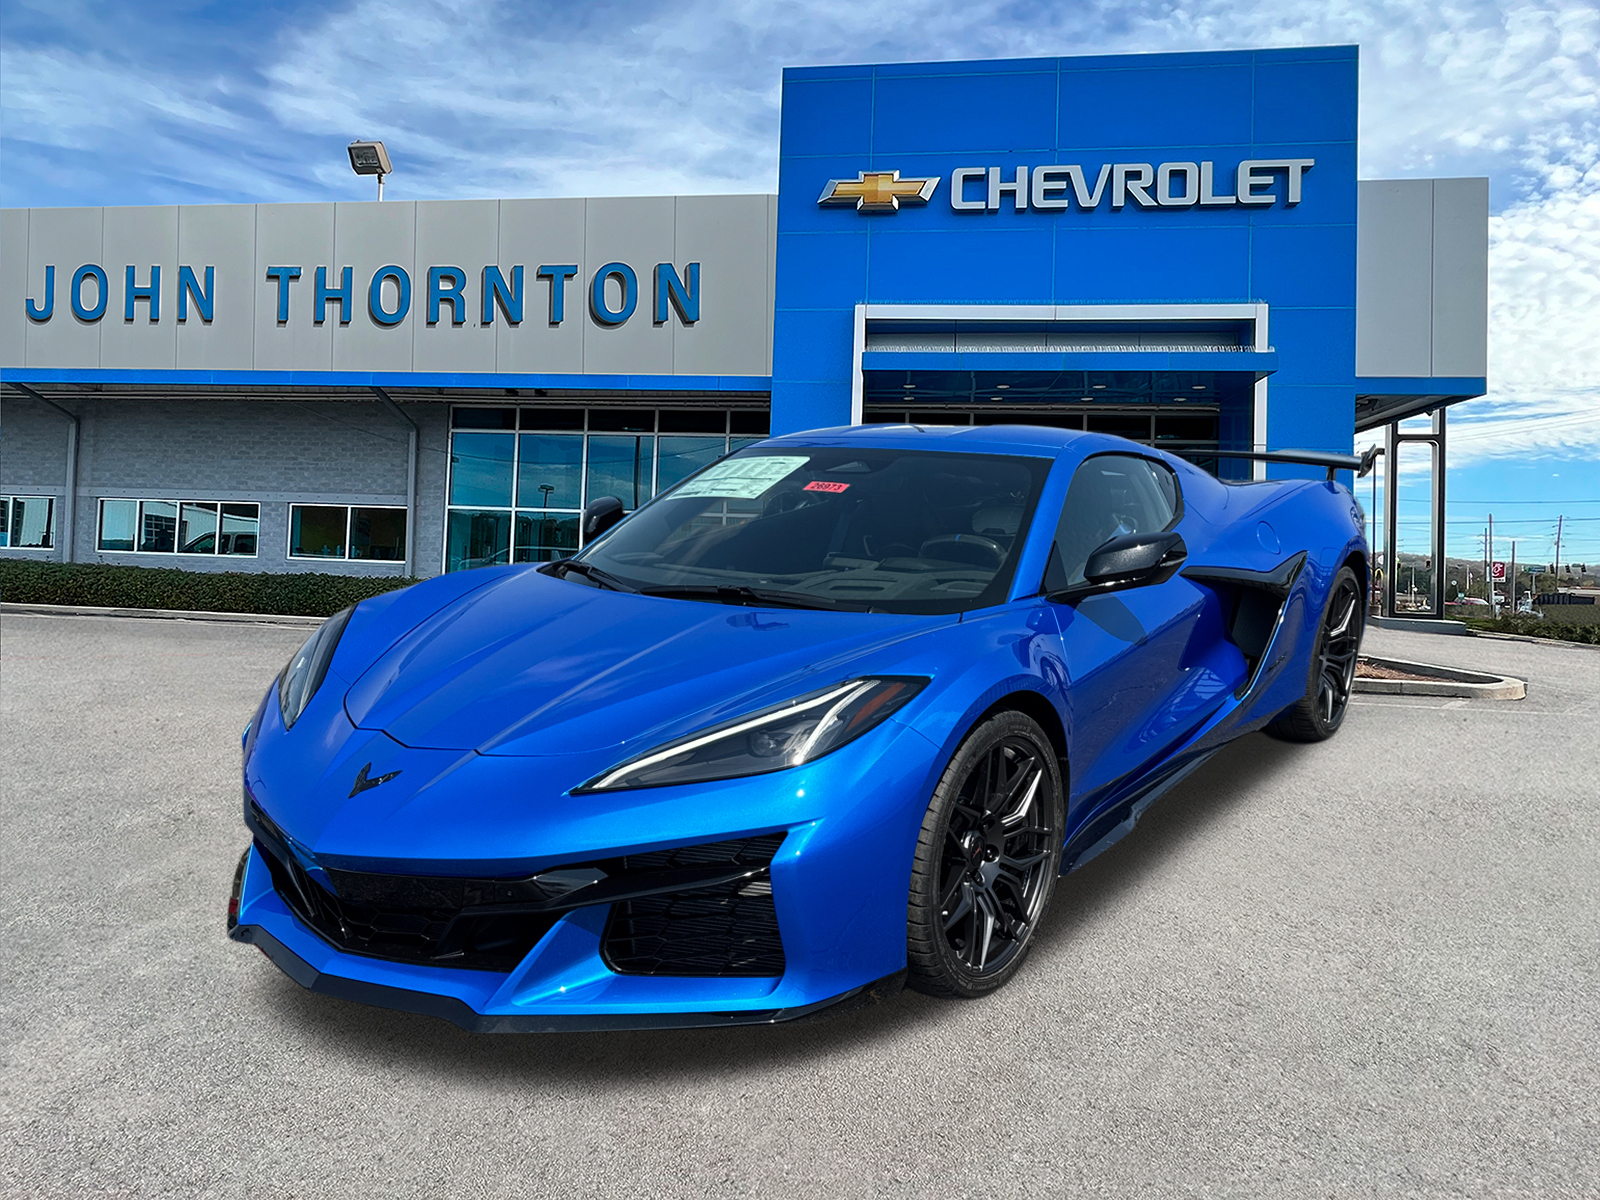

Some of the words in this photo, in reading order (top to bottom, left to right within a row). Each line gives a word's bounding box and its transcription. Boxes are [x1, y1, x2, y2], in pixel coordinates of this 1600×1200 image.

[951, 158, 1315, 211] CHEVROLET
[26, 264, 215, 323] JOHN
[266, 262, 702, 327] THORNTON
[810, 482, 843, 491] 26973
